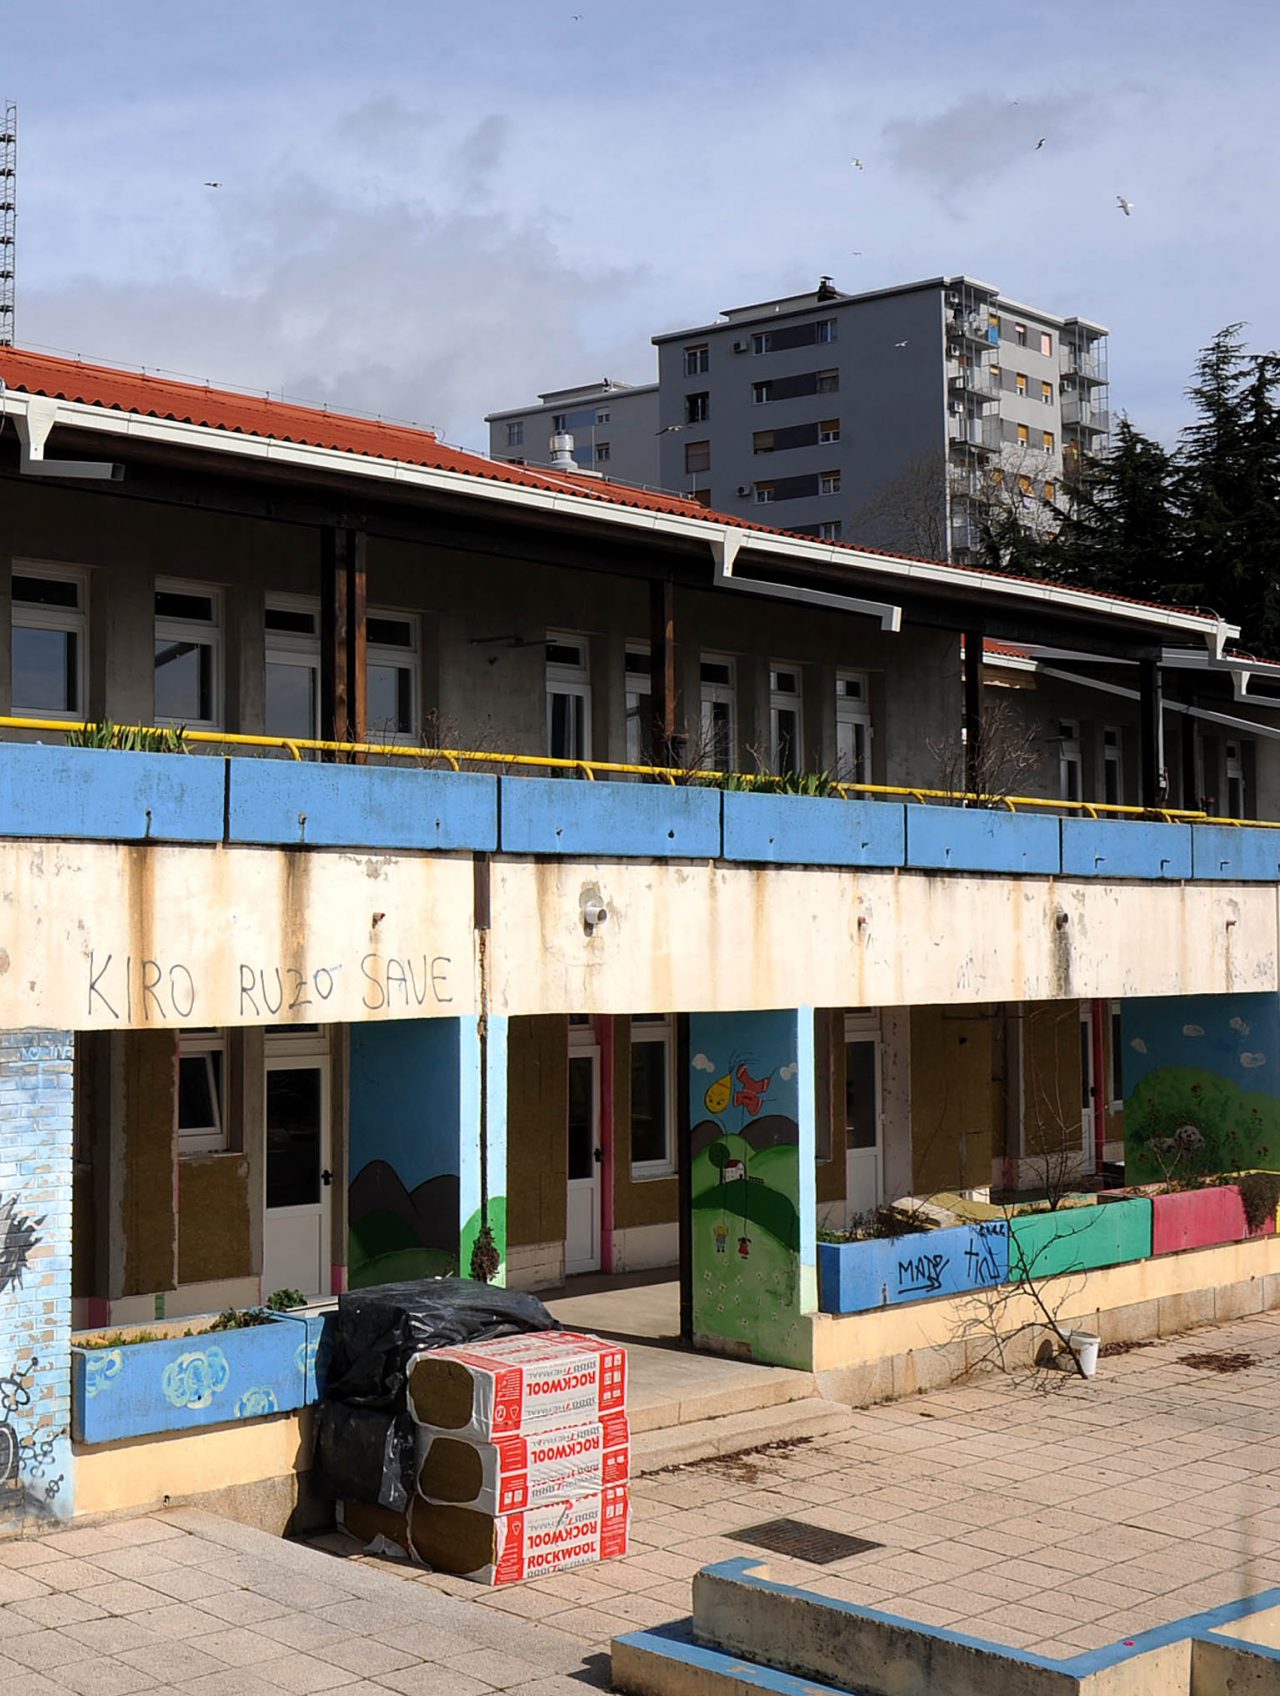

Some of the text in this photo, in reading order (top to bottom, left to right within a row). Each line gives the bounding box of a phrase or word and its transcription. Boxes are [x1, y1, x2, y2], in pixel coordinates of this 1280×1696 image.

[88, 951, 195, 1023] KIRO
[360, 953, 453, 1010] SAVE
[526, 1370, 597, 1396] ROCKWOOL
[530, 1435, 600, 1464] ROCKWOOL
[527, 1520, 598, 1549] ROCKWOOL
[527, 1541, 597, 1569] ROCKWOOL
